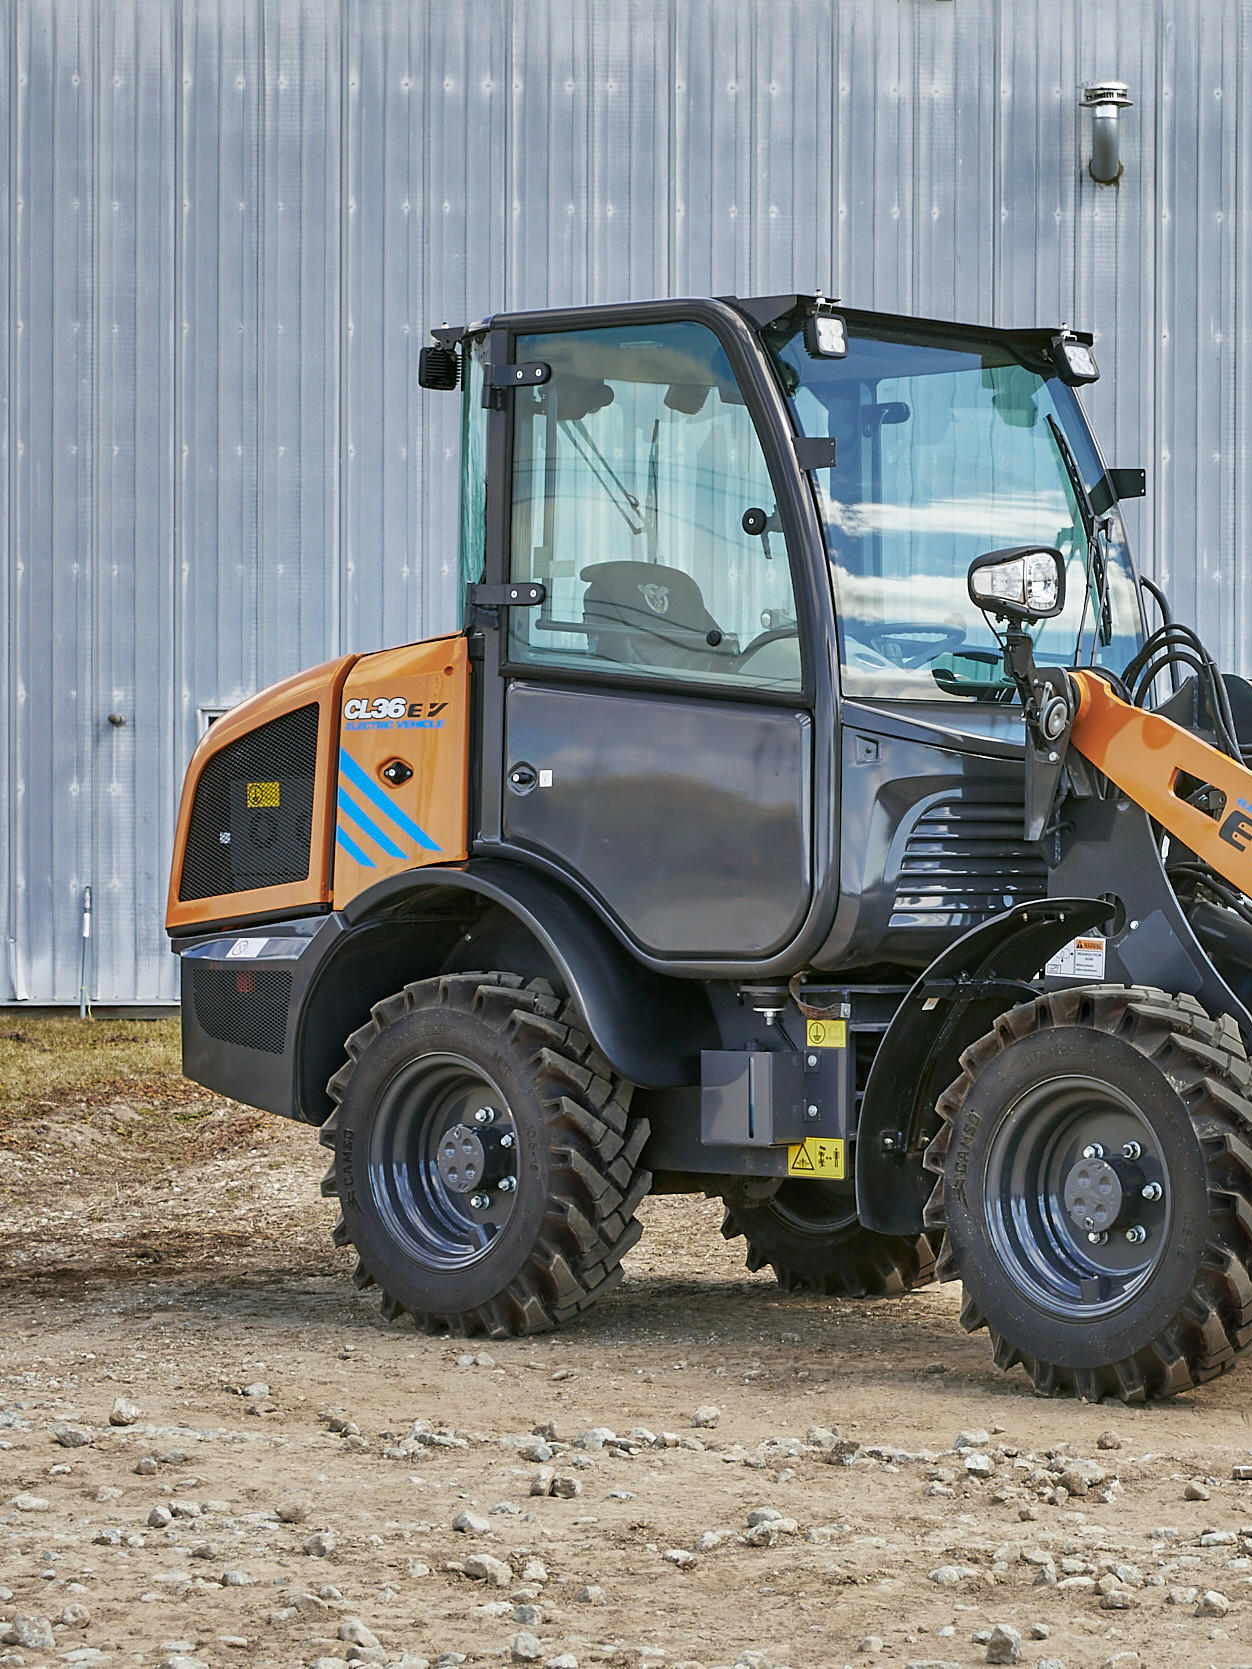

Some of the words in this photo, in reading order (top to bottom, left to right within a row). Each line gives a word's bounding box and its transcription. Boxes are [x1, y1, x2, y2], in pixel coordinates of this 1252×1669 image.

[343, 697, 407, 720] CL36
[345, 721, 394, 730] ELECTRIC
[396, 719, 445, 729] VEHICLE
